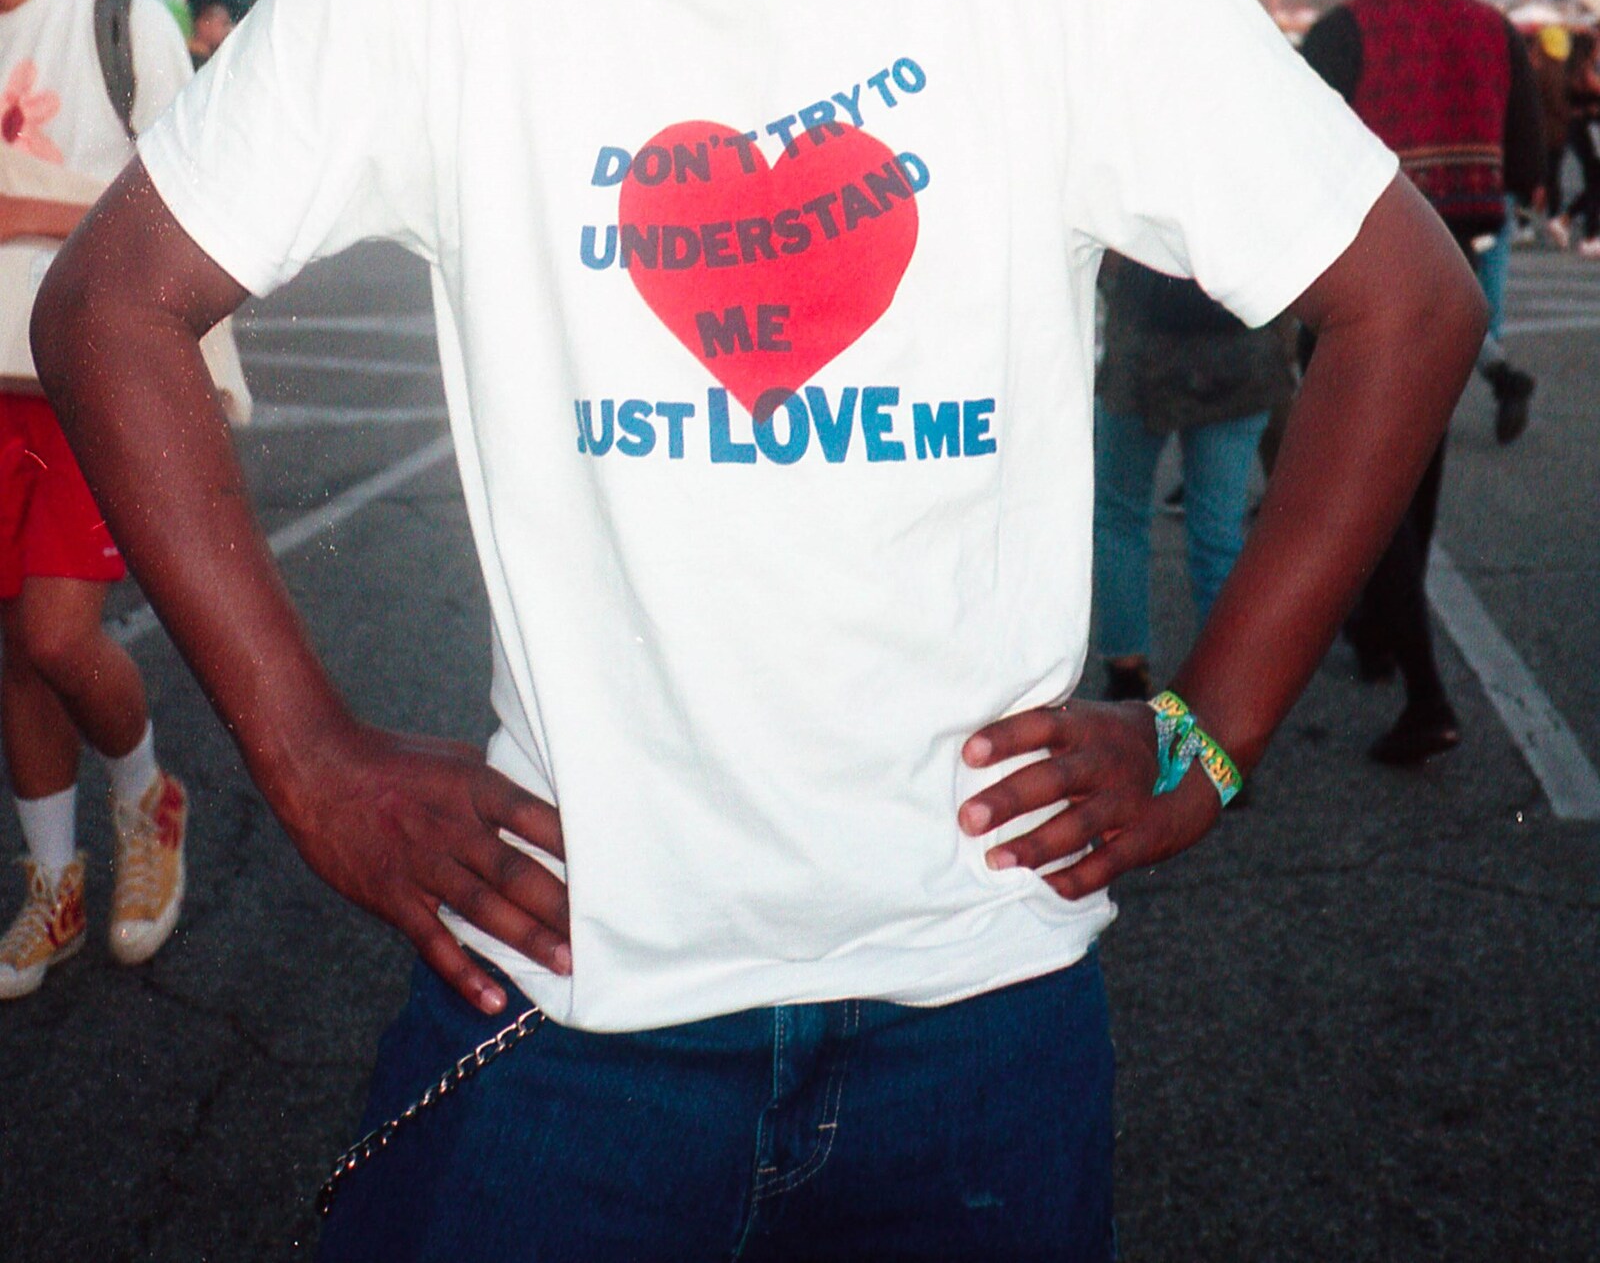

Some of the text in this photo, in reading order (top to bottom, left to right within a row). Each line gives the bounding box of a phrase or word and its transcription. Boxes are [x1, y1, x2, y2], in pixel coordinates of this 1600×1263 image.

[592, 57, 927, 187] DON'T TRY TO
[580, 152, 931, 270] UNDERSTAND
[695, 304, 792, 359] ME
[707, 386, 906, 465] LOVE
[912, 398, 997, 459] ME
